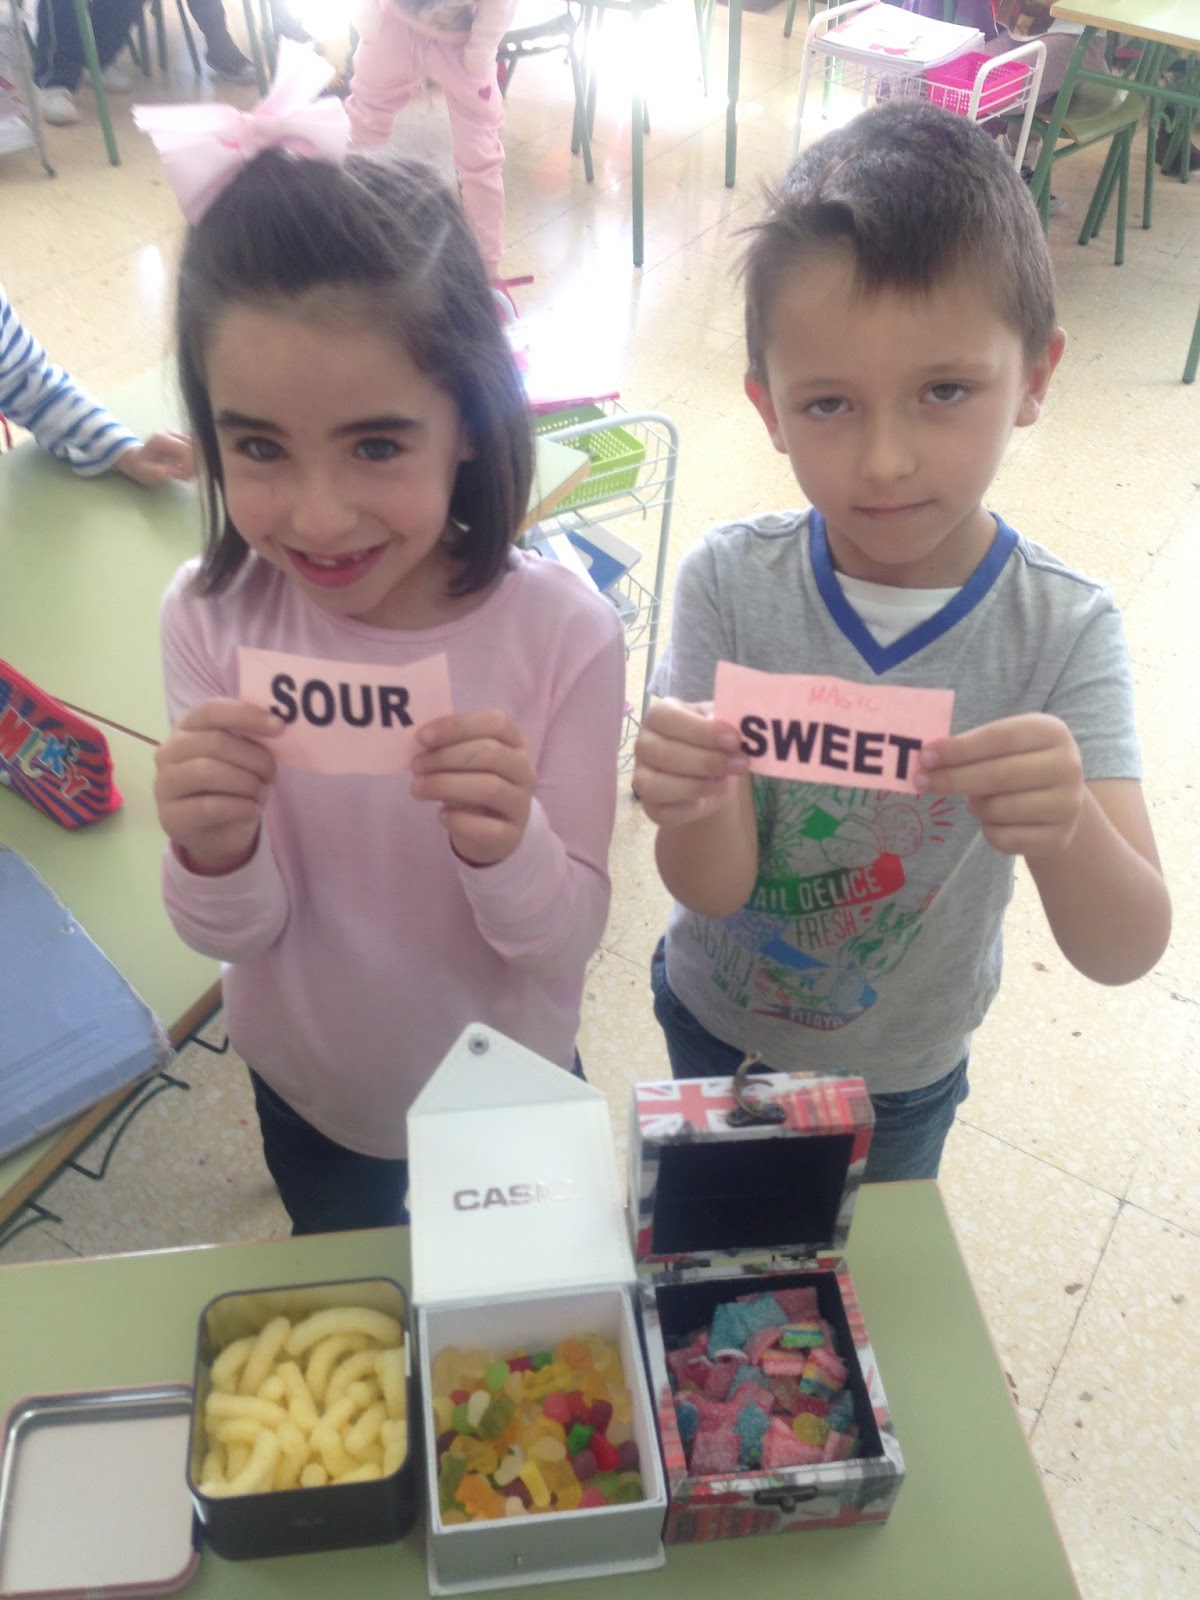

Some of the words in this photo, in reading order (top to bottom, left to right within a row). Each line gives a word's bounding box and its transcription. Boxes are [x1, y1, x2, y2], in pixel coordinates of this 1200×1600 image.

[270, 672, 414, 728] SOUR
[740, 714, 923, 780] SWEET
[798, 866, 882, 911] DELICE
[795, 906, 859, 950] FRESH
[452, 1181, 576, 1212] CASI
